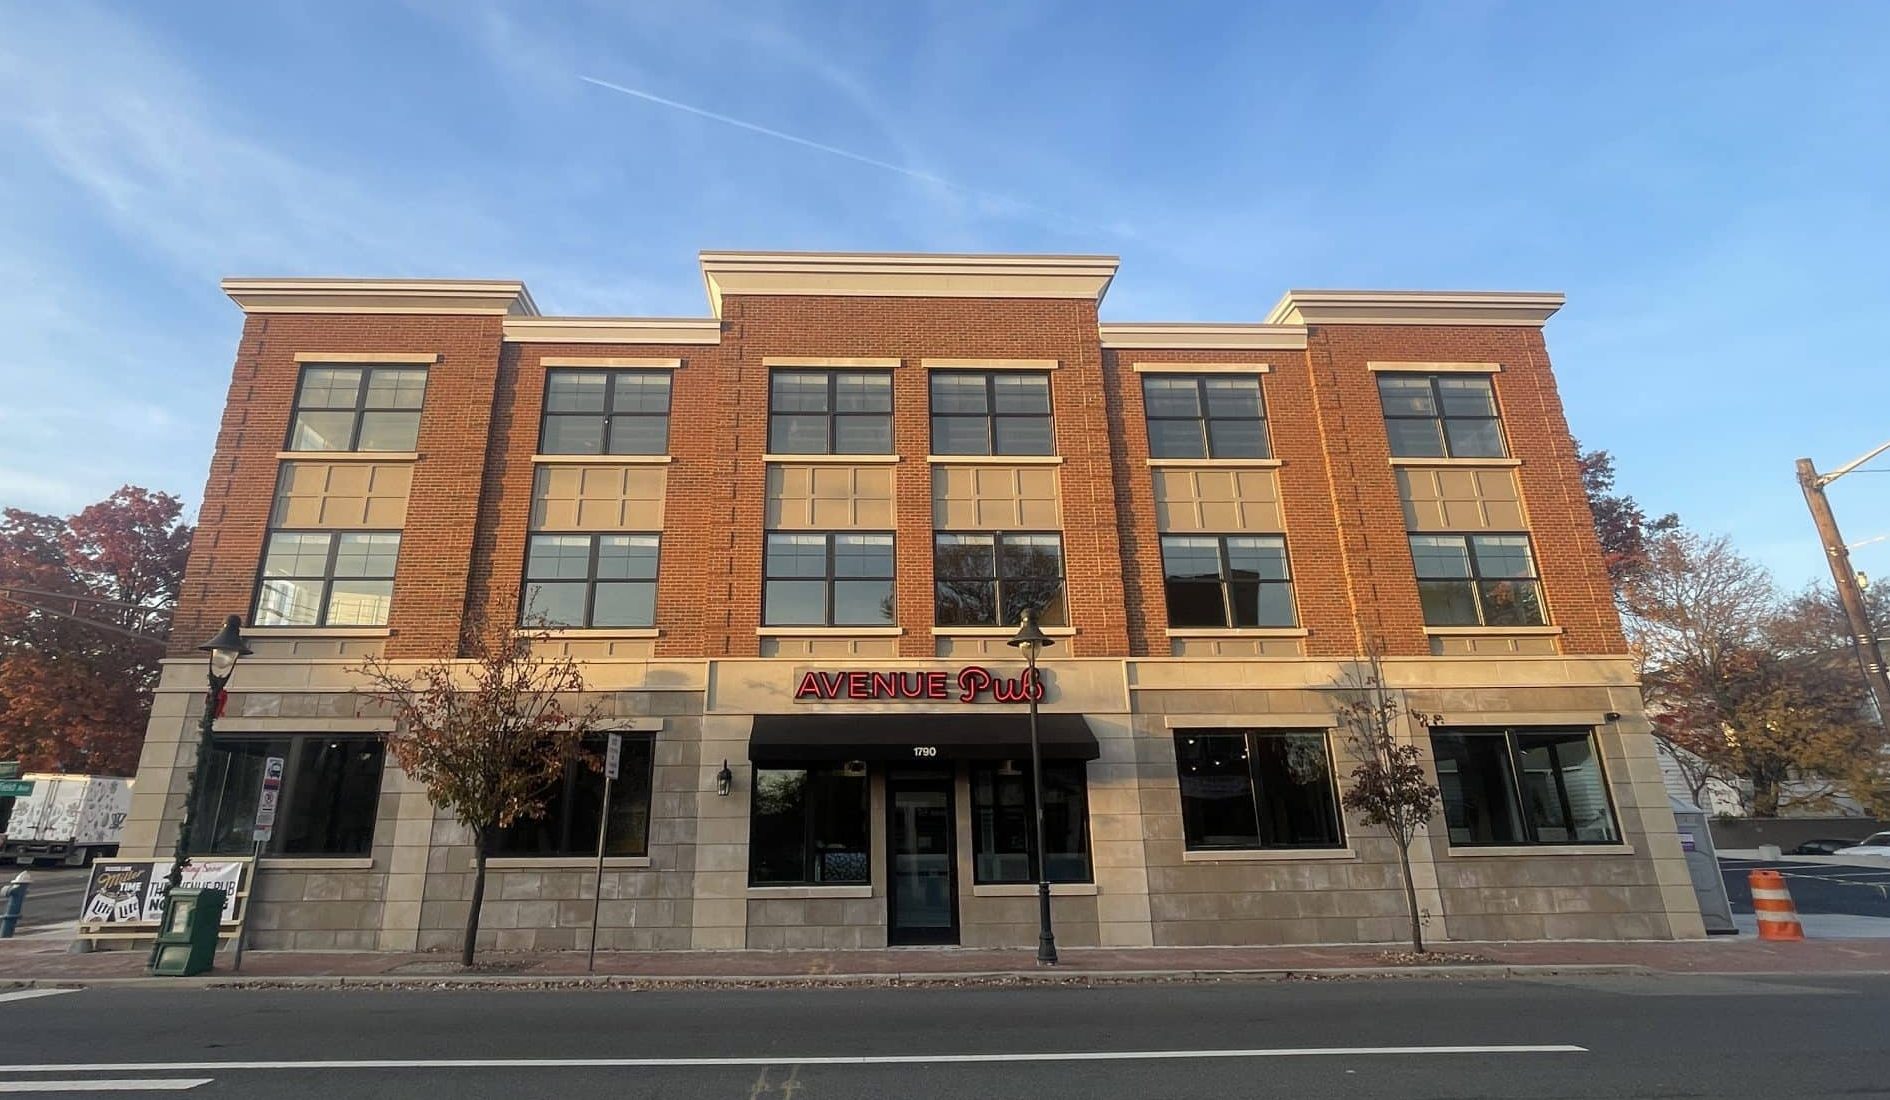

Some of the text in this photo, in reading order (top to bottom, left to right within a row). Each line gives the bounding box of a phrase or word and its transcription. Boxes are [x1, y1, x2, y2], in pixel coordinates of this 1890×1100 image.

[795, 665, 1045, 703] AVENUE Pub
[913, 747, 937, 757] 1790
[98, 870, 145, 889] Miller
[120, 882, 142, 892] TIME
